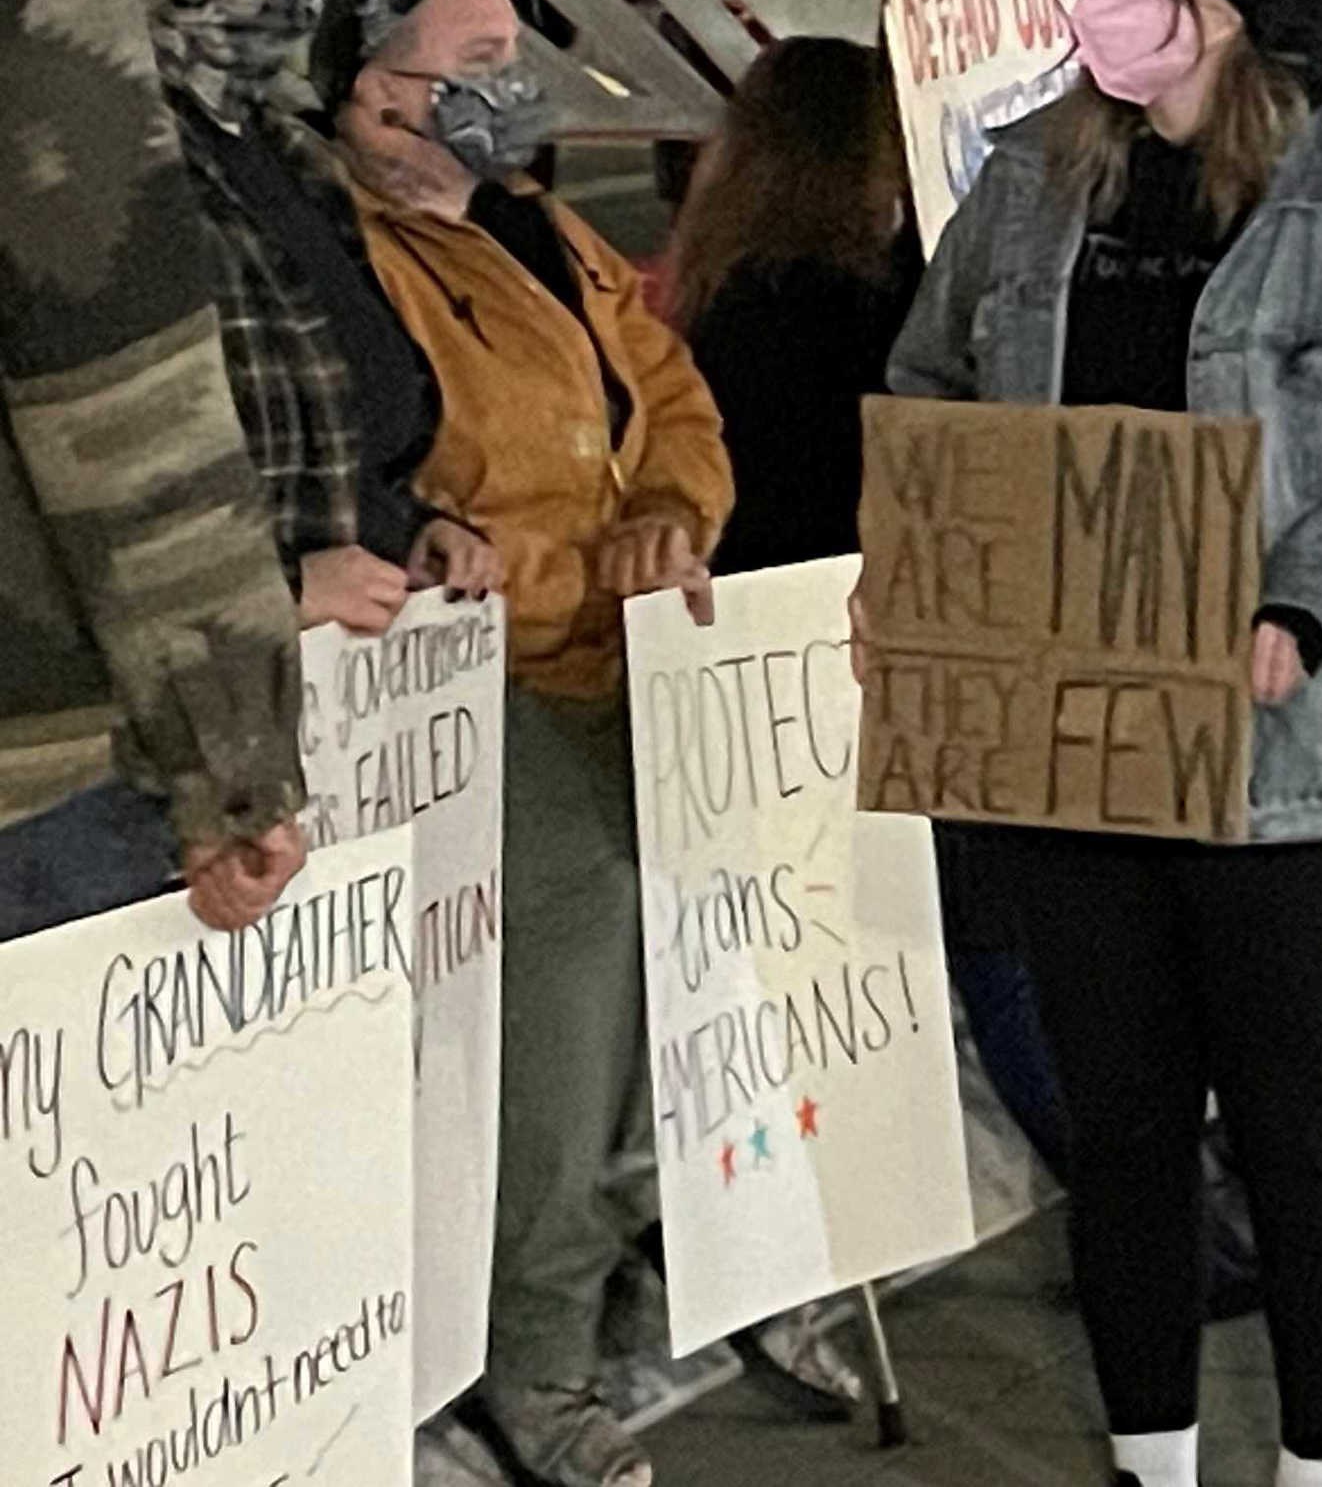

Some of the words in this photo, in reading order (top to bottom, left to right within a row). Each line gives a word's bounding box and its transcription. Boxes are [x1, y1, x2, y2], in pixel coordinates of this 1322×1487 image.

[881, 422, 1012, 523] WE
[1049, 420, 1262, 663] MANY
[886, 526, 1022, 627] ARE
[354, 705, 479, 839] FAILED
[648, 638, 853, 853] PROTEC
[867, 663, 1023, 745] THEY
[874, 735, 1019, 816] ARE
[1045, 679, 1237, 839] FEW
[98, 865, 412, 1109] GRANDFATHER
[676, 863, 802, 993] trans
[658, 950, 920, 1161] AMERICANS!
[64, 1112, 250, 1300] fought
[57, 1242, 258, 1445] NAZIS
[294, 1299, 371, 1405] need
[378, 1290, 407, 1341] to
